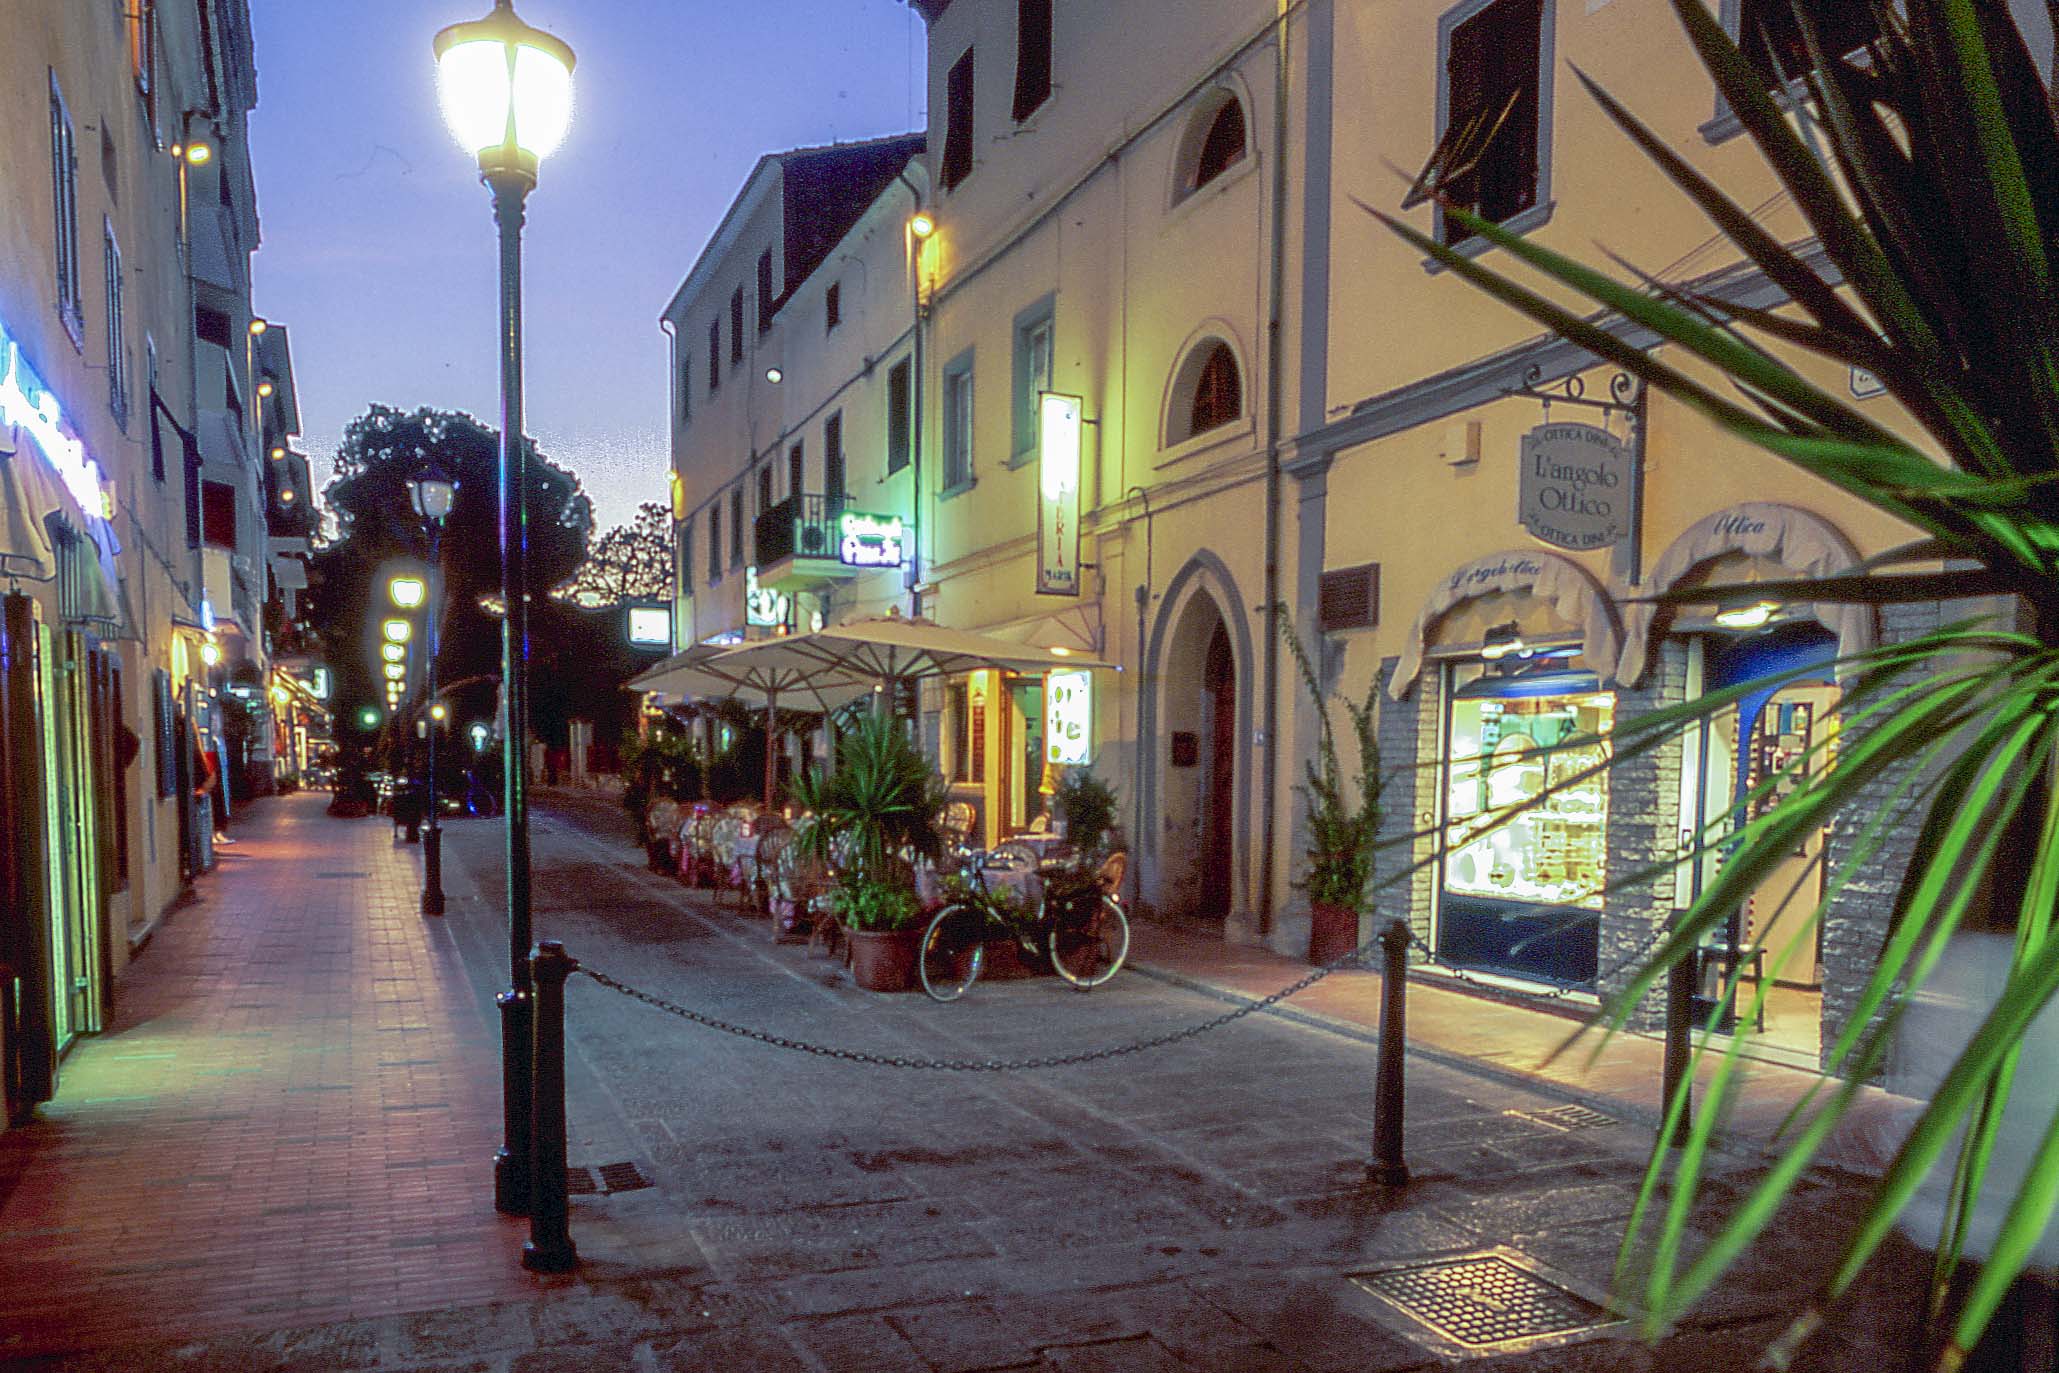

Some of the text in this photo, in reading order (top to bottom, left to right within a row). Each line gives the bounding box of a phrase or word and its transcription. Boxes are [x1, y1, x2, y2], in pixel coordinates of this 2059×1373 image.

[1544, 428, 1583, 443] OTTICA
[1535, 454, 1618, 491] L'angolo
[1539, 486, 1611, 517] Ottico
